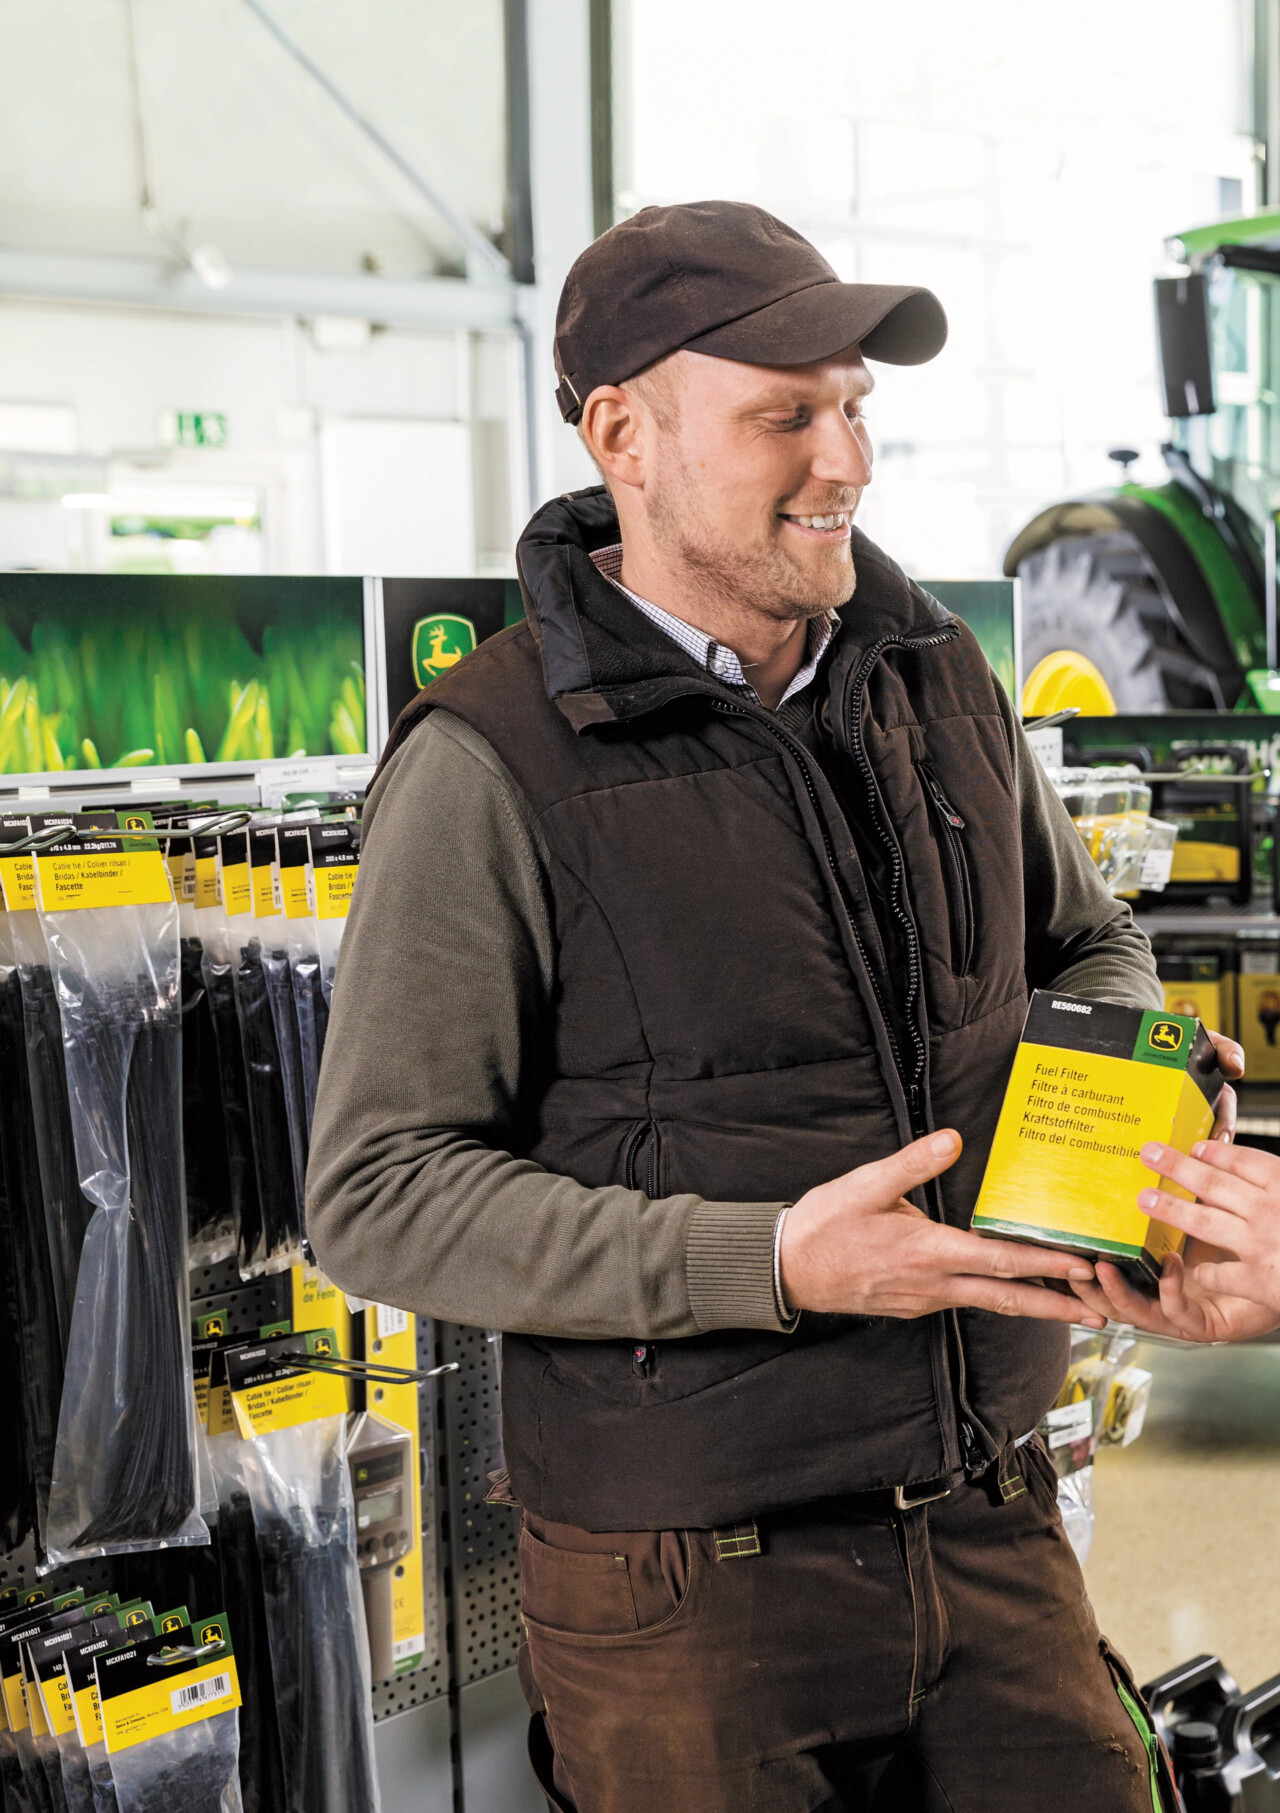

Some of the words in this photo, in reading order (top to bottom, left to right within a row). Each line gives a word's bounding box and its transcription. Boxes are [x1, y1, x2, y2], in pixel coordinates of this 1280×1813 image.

[1051, 1000, 1092, 1015] RE560682
[1035, 1063, 1058, 1078] Fuel
[1060, 1067, 1089, 1082] Filter
[1030, 1079, 1058, 1095] Filtre
[1061, 1083, 1068, 1095] à
[1071, 1087, 1124, 1106] carburant
[1026, 1095, 1054, 1110] Filtro
[1056, 1100, 1071, 1113] de
[1073, 1104, 1141, 1126] combustible
[1022, 1111, 1096, 1134] Kraftstoffilter
[1018, 1127, 1046, 1142] Filtro
[1048, 1131, 1066, 1146] del
[1069, 1136, 1141, 1160] combustibile
[106, 1650, 137, 1666] MCXFA1021
